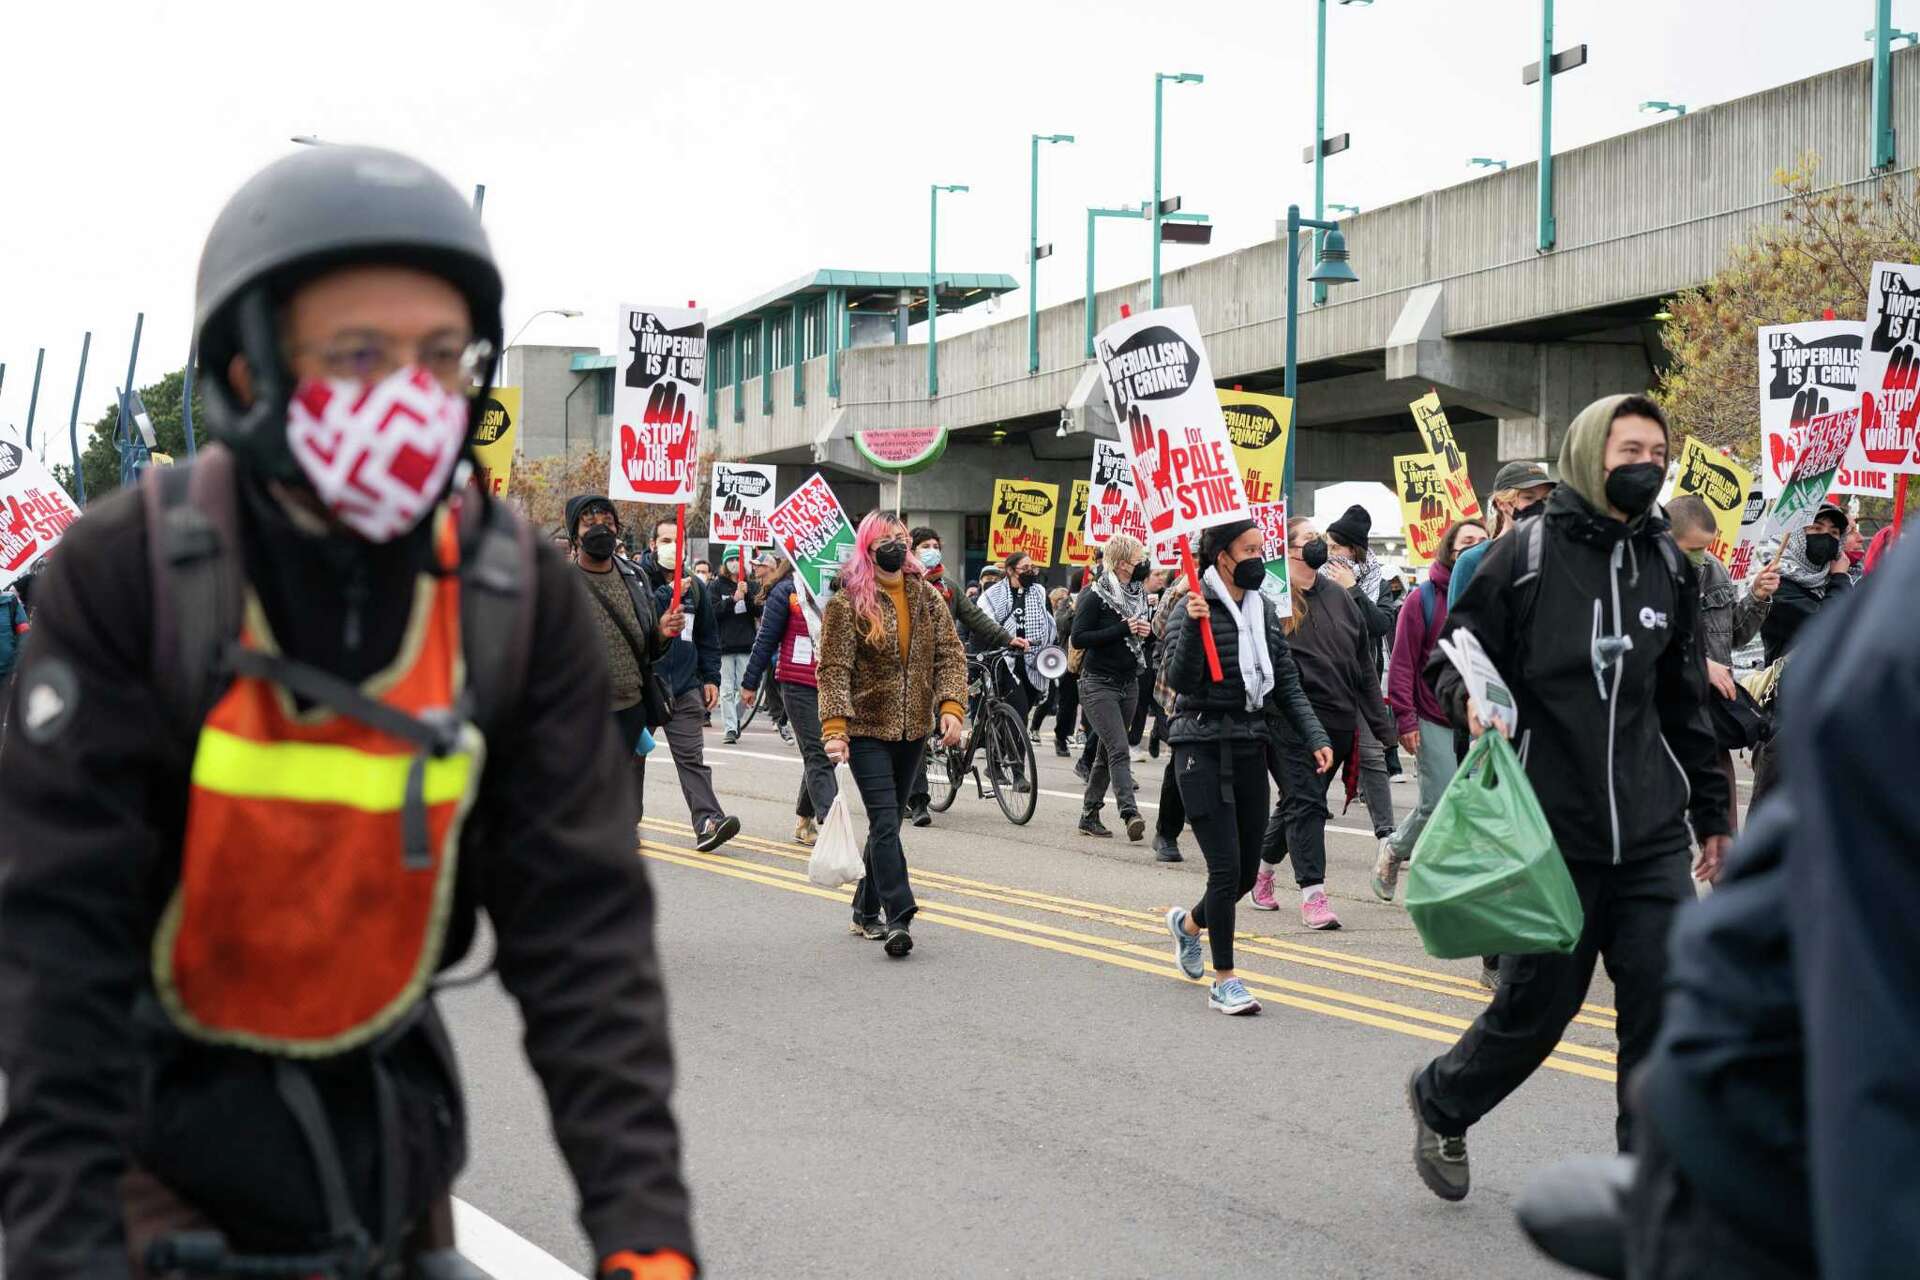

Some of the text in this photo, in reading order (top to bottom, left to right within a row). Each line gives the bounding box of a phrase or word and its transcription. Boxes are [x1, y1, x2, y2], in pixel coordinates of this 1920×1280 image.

[1882, 271, 1903, 293] U.S.
[632, 312, 658, 334] U.S.
[1888, 316, 1916, 340] IS A
[1771, 333, 1797, 350] U.S.
[645, 354, 662, 375] IS
[667, 357, 677, 378] A
[1107, 341, 1189, 383] IMPERIALISM
[1788, 366, 1859, 385] IS A CRIM
[1116, 380, 1127, 405] IS
[1134, 366, 1188, 397] CRIME!
[1878, 388, 1914, 411] STOP
[1881, 411, 1900, 428] THE
[641, 422, 683, 445] STOP
[1185, 427, 1202, 444] for
[1229, 426, 1267, 448] CRIME!
[1865, 427, 1913, 449] WORLD
[645, 443, 669, 461] THE
[1099, 444, 1112, 457] U.S.
[1691, 444, 1703, 460] U.S.
[627, 459, 683, 481] WORLD
[1171, 441, 1229, 484] PALE
[1401, 461, 1418, 472] U.S.
[1797, 461, 1837, 482] ISRAEL
[721, 475, 766, 487] IMPERIALISM
[1104, 467, 1112, 479] IS
[1113, 468, 1119, 480] A
[1248, 468, 1261, 481] for
[1692, 458, 1739, 500] IMPERIALISM
[24, 487, 41, 499] for
[724, 483, 731, 492] IS
[738, 485, 762, 496] CRIME!
[1415, 482, 1425, 494] IS
[1426, 482, 1434, 494] A
[1692, 475, 1701, 488] IS
[1706, 484, 1732, 510] CRIME!
[20, 491, 69, 522] PALE
[1005, 493, 1049, 507] IMPERIALISM
[1006, 501, 1012, 510] IS
[1176, 476, 1241, 520] STINE
[772, 501, 800, 531] CUT
[783, 485, 829, 538] MILITARY
[1102, 504, 1119, 516] STOP
[744, 515, 768, 529] PALE
[792, 502, 831, 541] AID TO
[1093, 522, 1120, 535] WORLD
[1420, 517, 1444, 531] STOP
[742, 528, 769, 542] STINE
[793, 510, 839, 560] APARTHEID
[800, 521, 844, 563] ISRAEL
[1026, 533, 1048, 548] PALE
[1731, 546, 1755, 564] PALE
